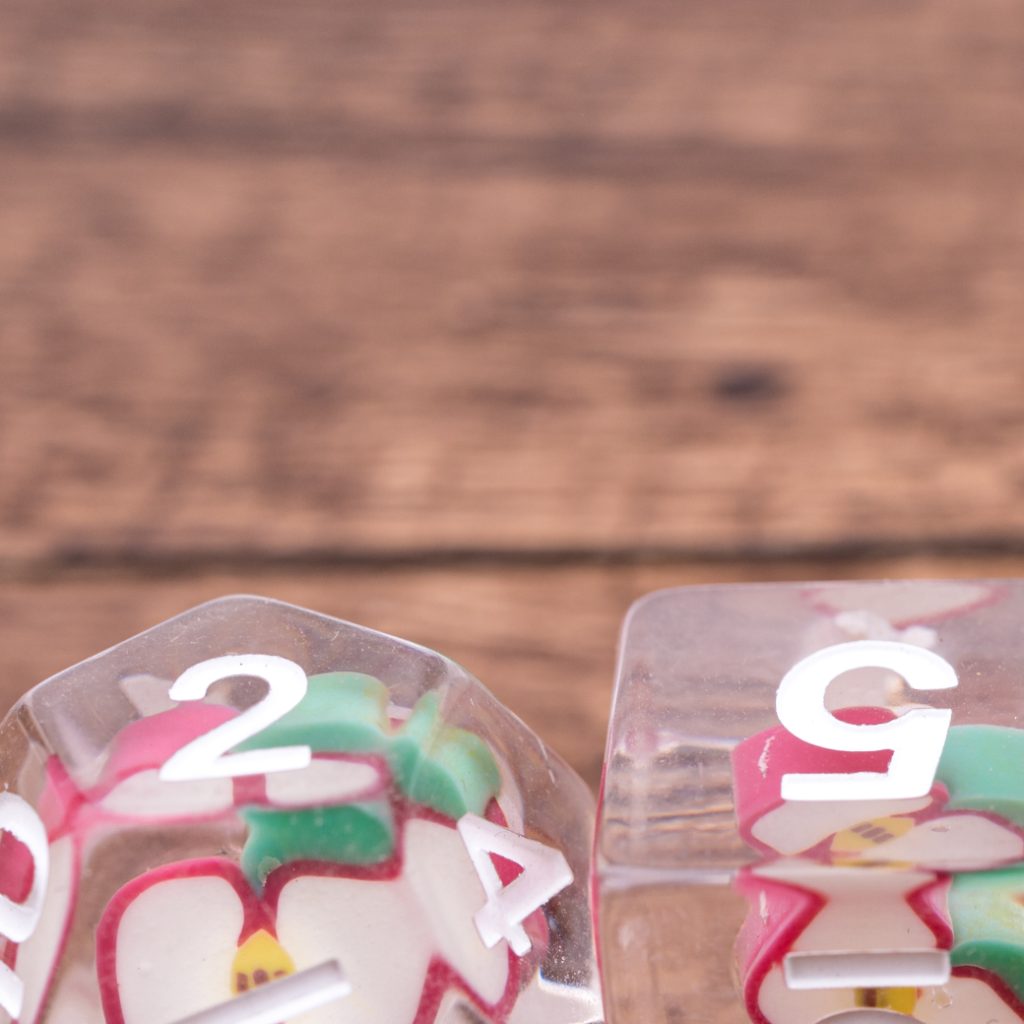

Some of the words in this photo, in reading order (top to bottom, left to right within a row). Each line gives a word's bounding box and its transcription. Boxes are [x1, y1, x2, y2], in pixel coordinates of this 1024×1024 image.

[158, 653, 312, 782] 2
[775, 640, 959, 801] 5
[456, 812, 575, 957] 4
